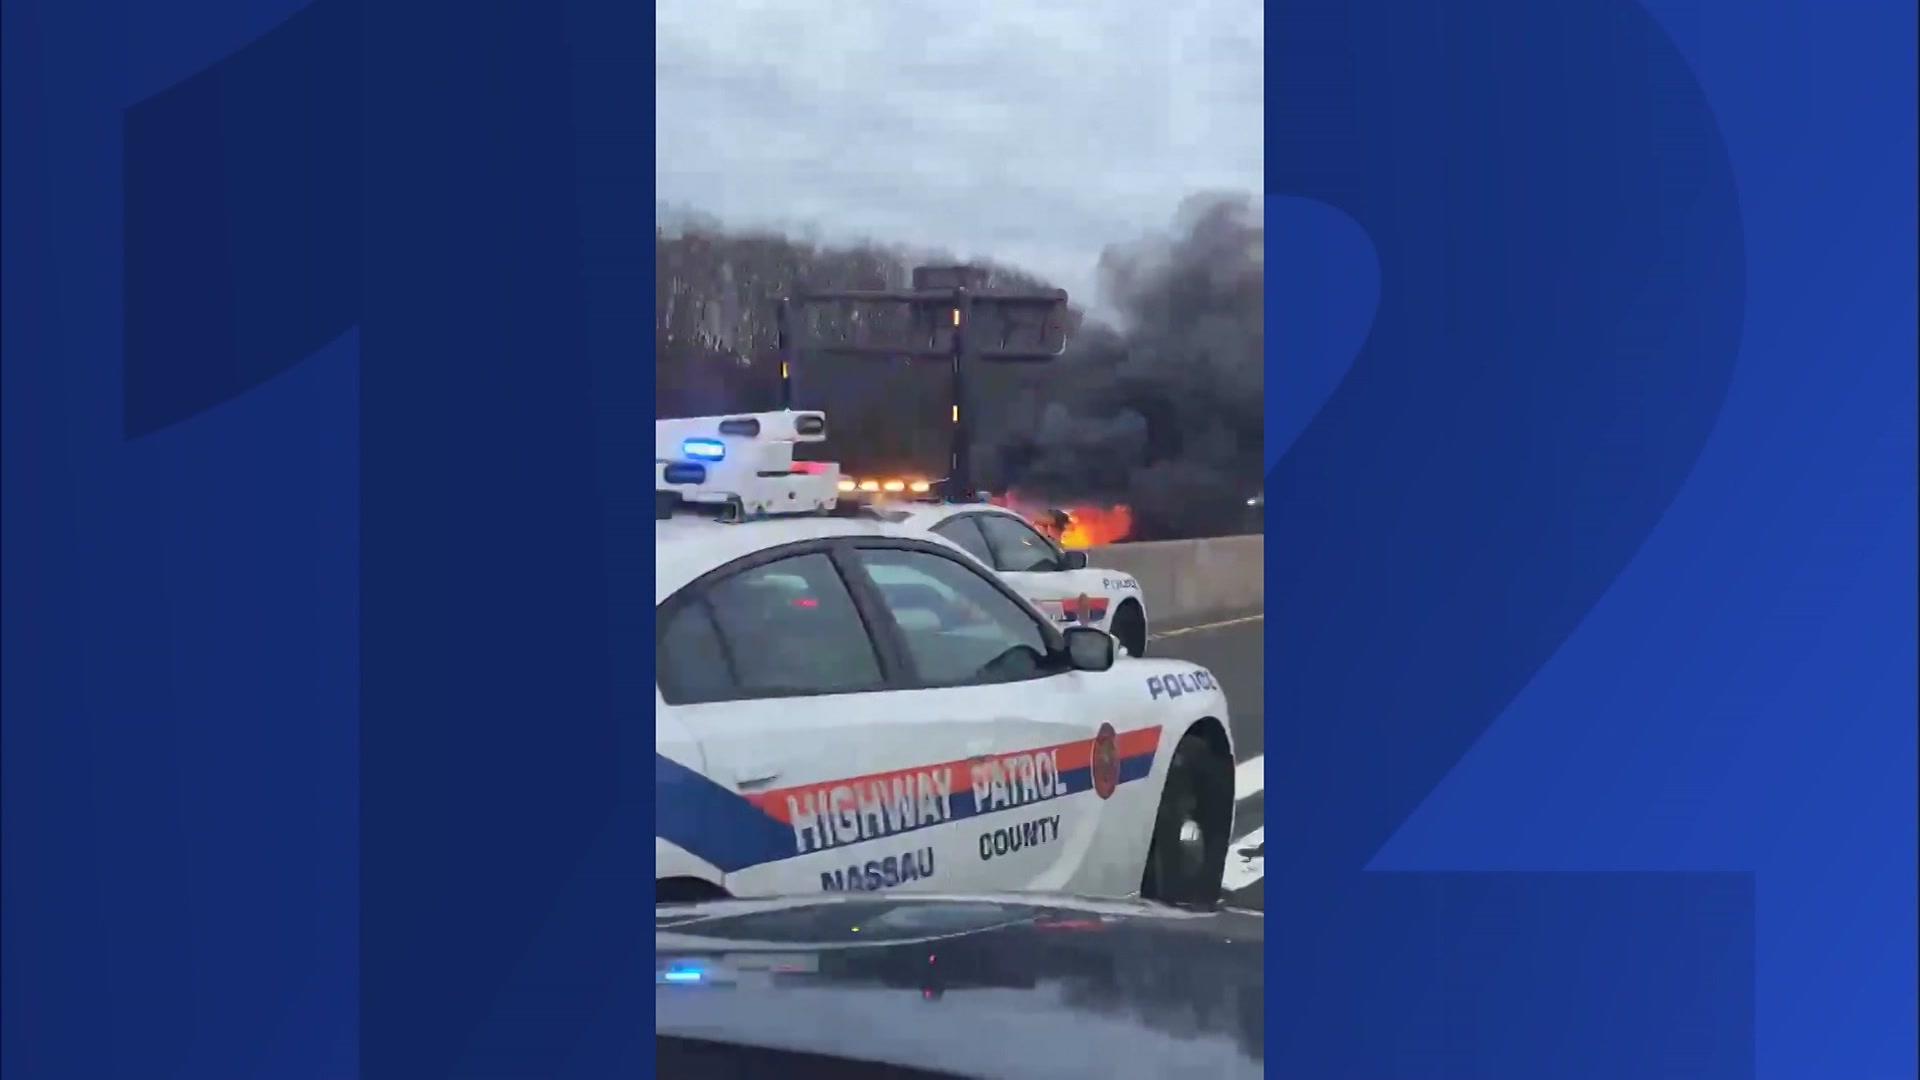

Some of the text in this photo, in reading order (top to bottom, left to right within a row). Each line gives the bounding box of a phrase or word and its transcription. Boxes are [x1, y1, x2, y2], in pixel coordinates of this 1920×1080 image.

[787, 749, 1067, 853] HIGHWAY PATROL
[821, 814, 1060, 891] NASSAU COUNTY
